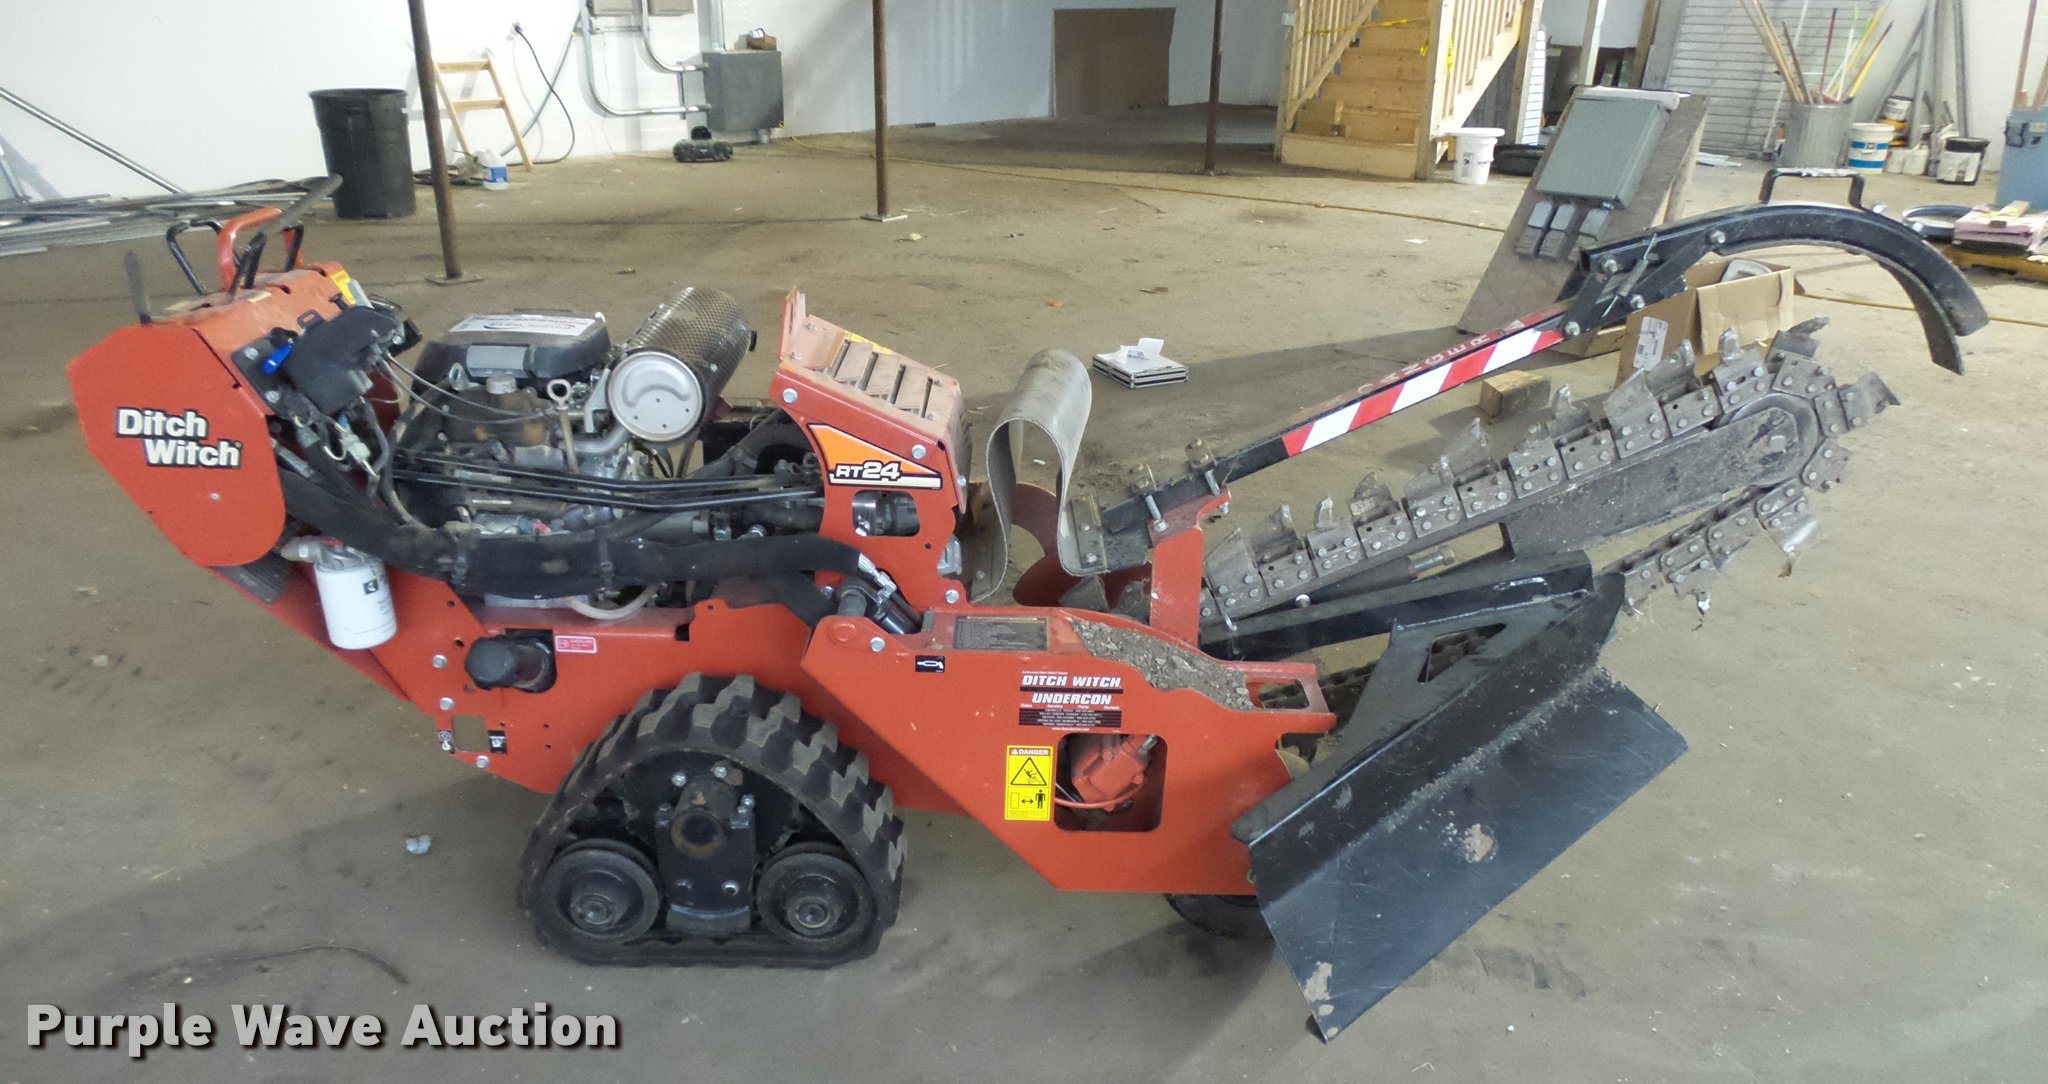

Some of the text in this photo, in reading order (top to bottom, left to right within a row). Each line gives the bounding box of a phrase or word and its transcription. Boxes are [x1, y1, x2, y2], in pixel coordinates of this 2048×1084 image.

[117, 408, 207, 438] Ditch
[144, 438, 241, 467] Witch
[835, 461, 900, 480] RT24
[1022, 674, 1121, 688] DITCH WITCH
[1031, 693, 1112, 705] UNDERCON
